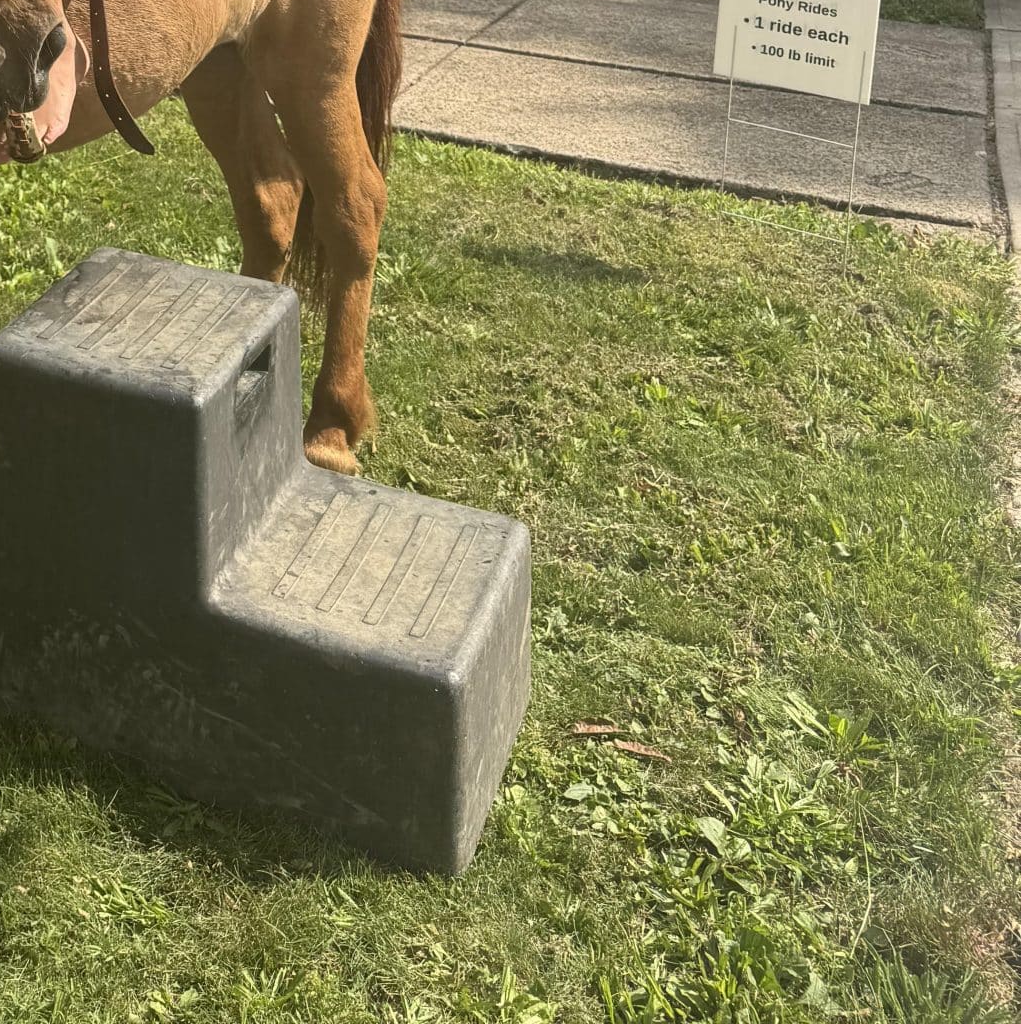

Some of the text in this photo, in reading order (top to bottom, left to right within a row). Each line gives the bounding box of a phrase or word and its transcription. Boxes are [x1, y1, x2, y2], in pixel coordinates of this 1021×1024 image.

[798, 0, 838, 18] Rides
[754, 16, 850, 46] 1 ride each
[760, 44, 836, 69] 100 lb limit
